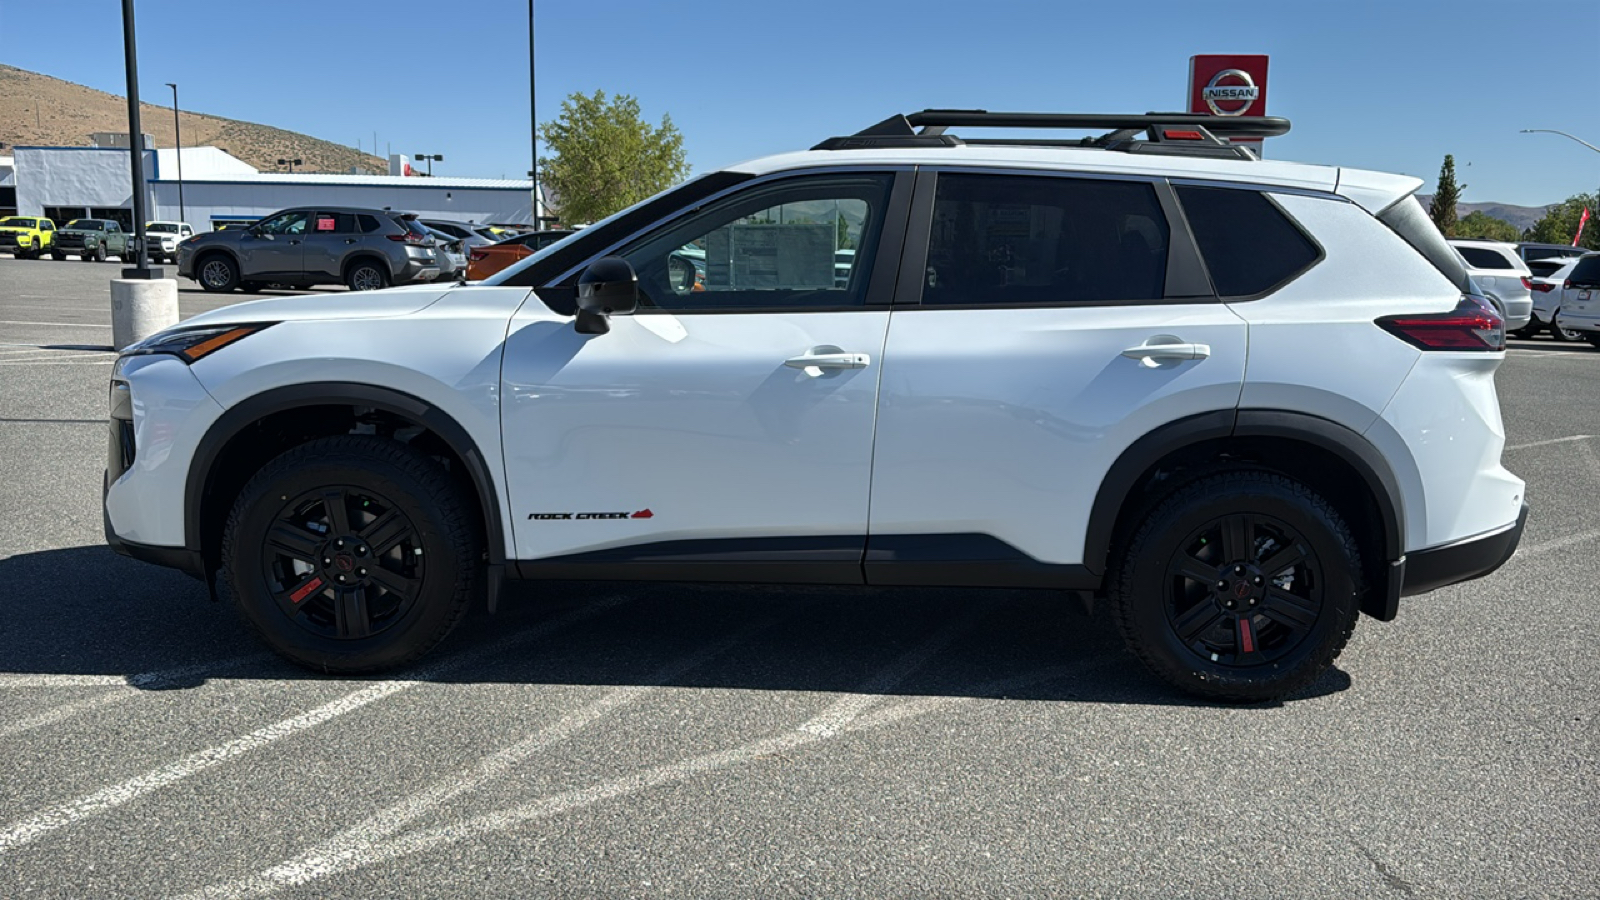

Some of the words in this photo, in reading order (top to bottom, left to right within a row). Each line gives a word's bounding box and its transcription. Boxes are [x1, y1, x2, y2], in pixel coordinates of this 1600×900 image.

[1209, 89, 1253, 97] NISSAN
[528, 512, 574, 520] ROCK
[576, 512, 630, 520] CREEK
